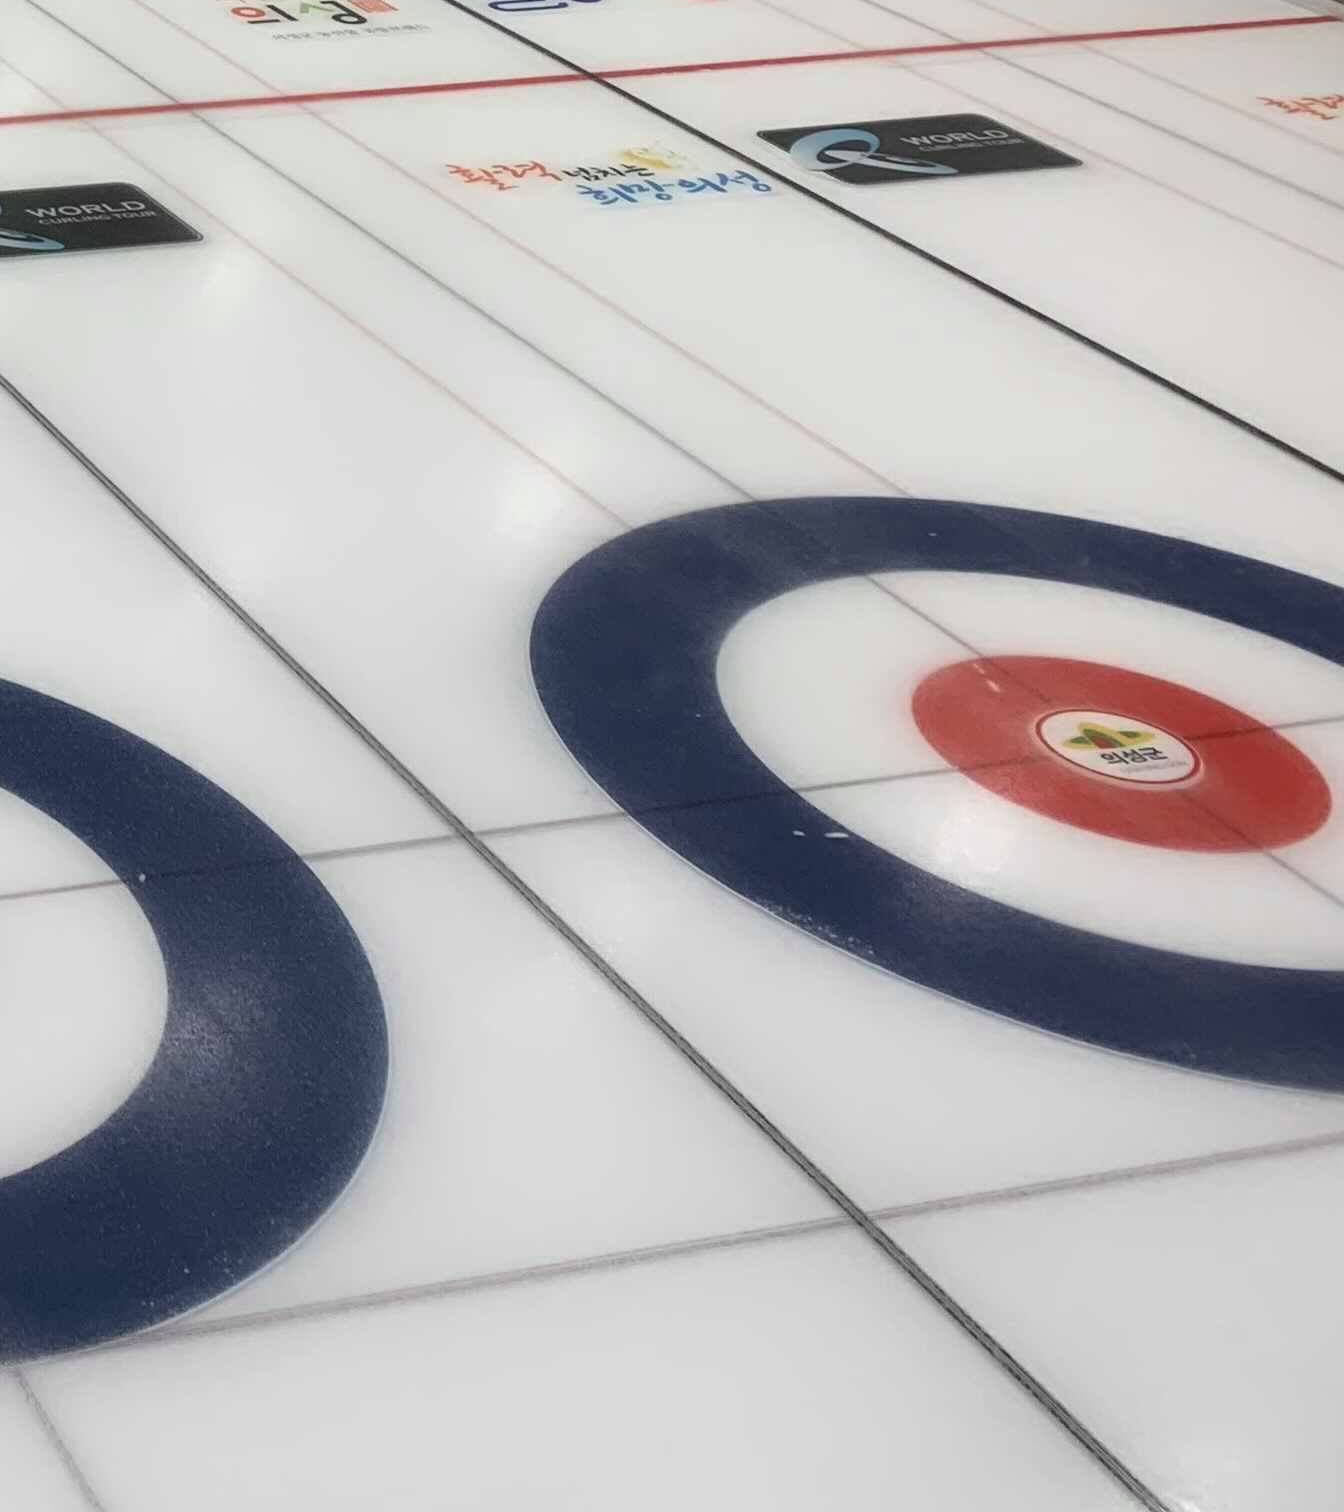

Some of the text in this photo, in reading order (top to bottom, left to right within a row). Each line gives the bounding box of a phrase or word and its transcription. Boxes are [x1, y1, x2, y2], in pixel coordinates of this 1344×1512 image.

[899, 130, 1009, 145] WORLD
[25, 200, 146, 219] WORLD
[38, 210, 157, 226] CURLING TOUR
[1100, 746, 1169, 765] 의성군
